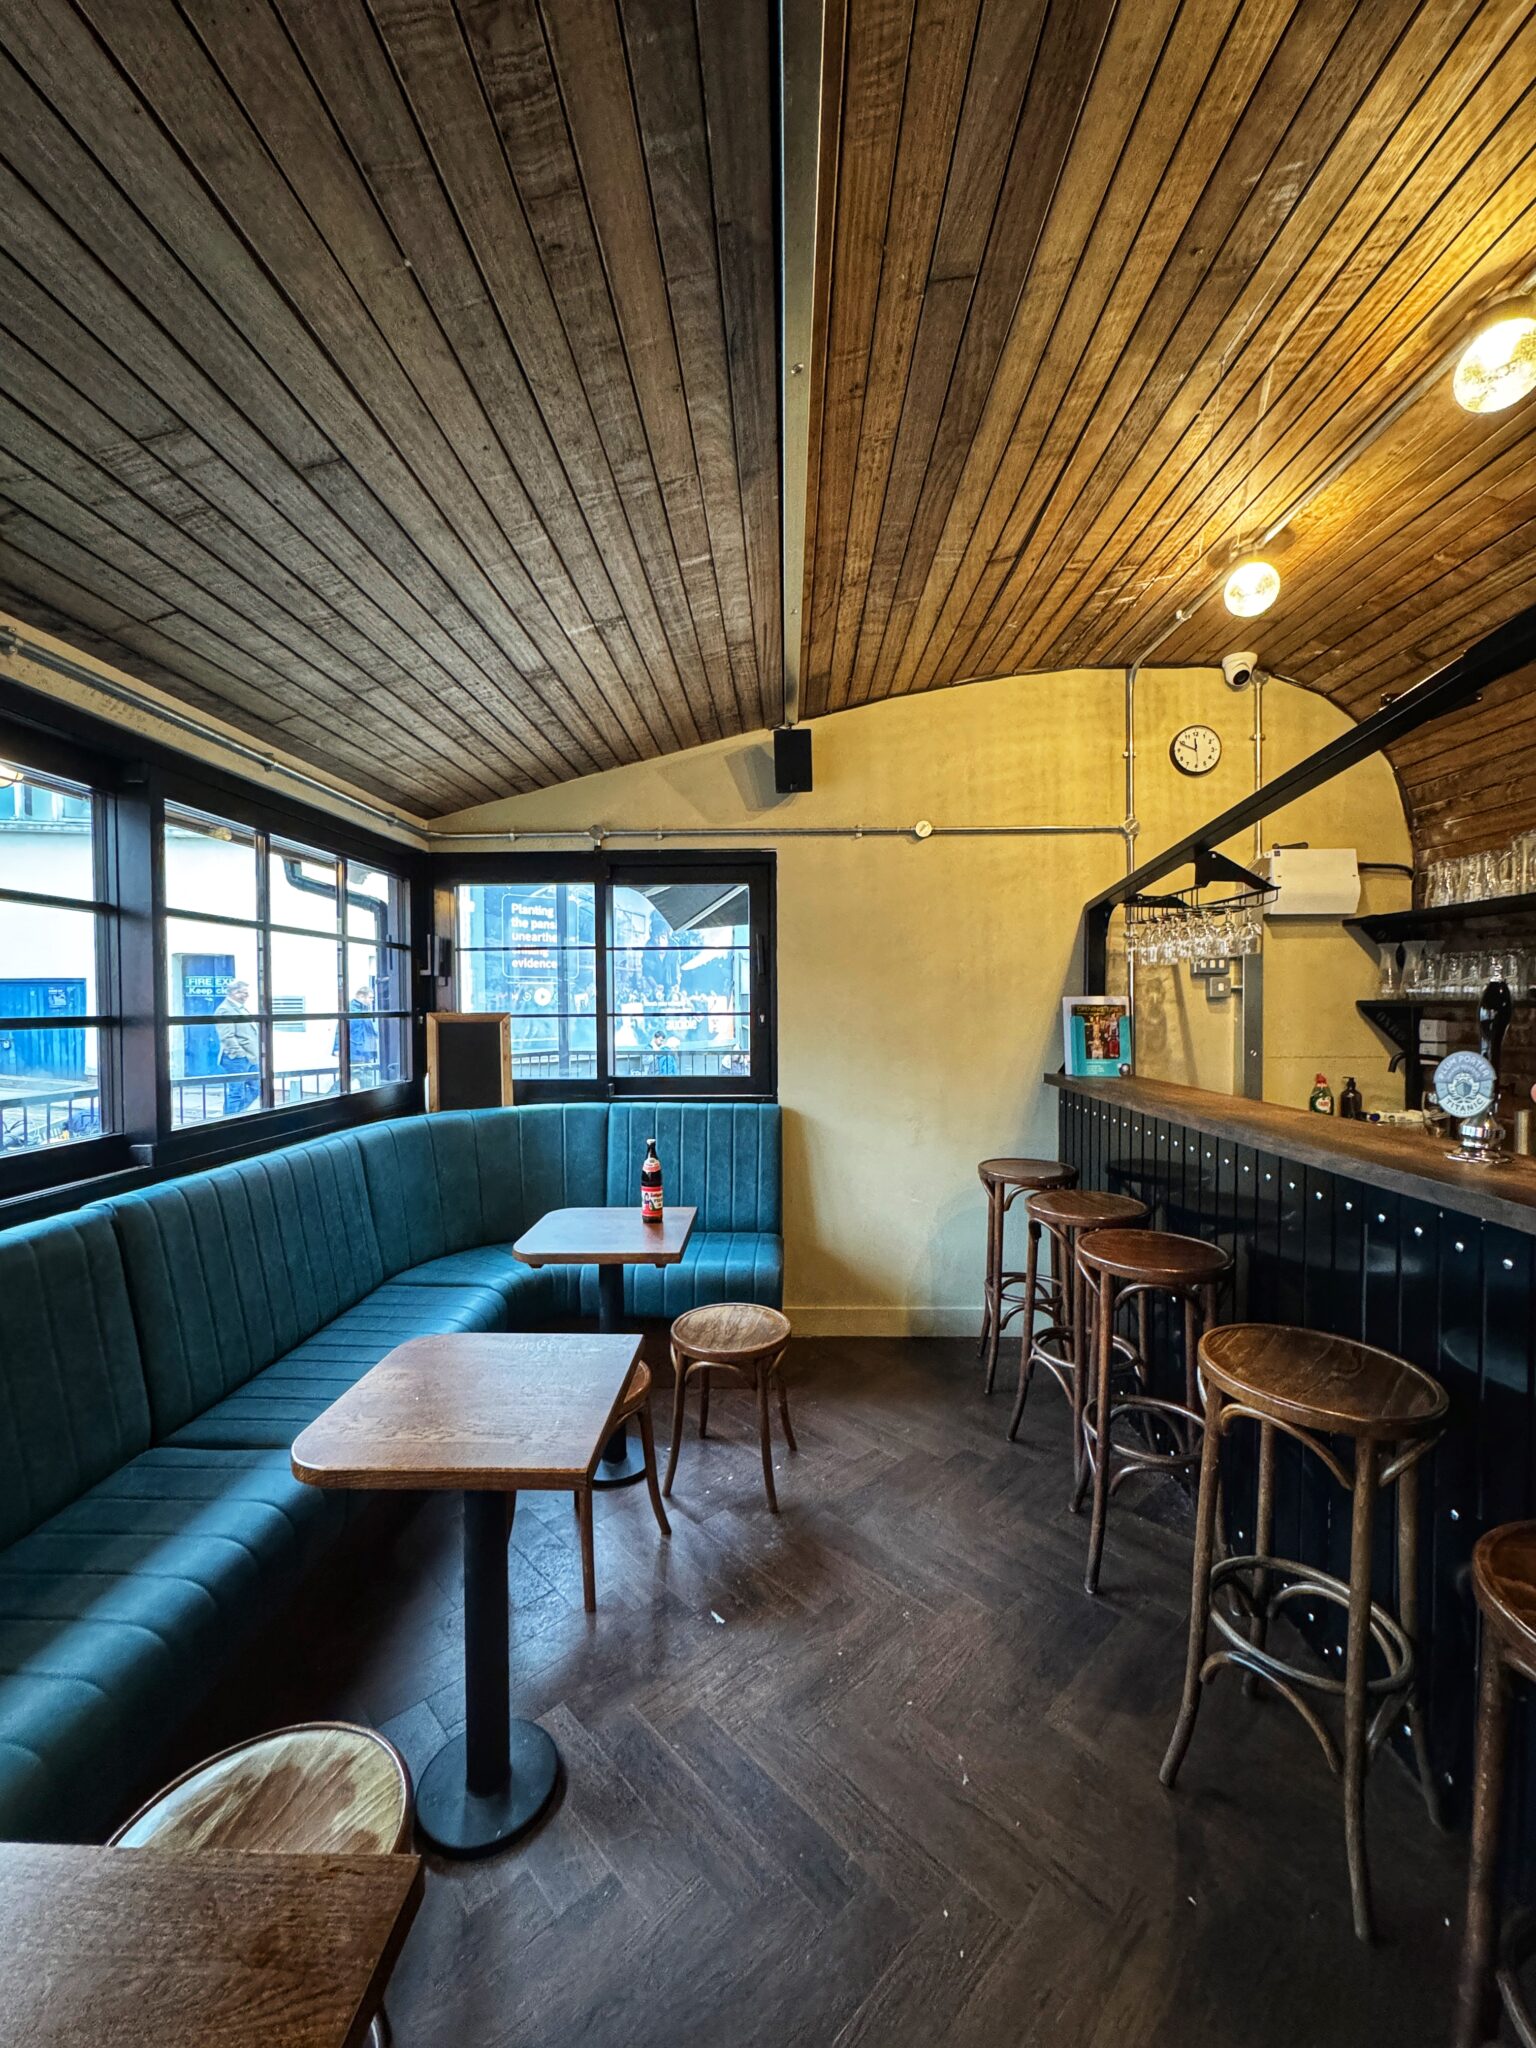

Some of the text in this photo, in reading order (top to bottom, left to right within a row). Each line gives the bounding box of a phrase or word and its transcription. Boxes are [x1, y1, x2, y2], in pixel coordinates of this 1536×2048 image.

[511, 903, 554, 919] Planting
[511, 917, 528, 928] the
[188, 977, 212, 986] FIRE
[188, 986, 213, 996] Keep
[1447, 1098, 1483, 1111] TITANIC
